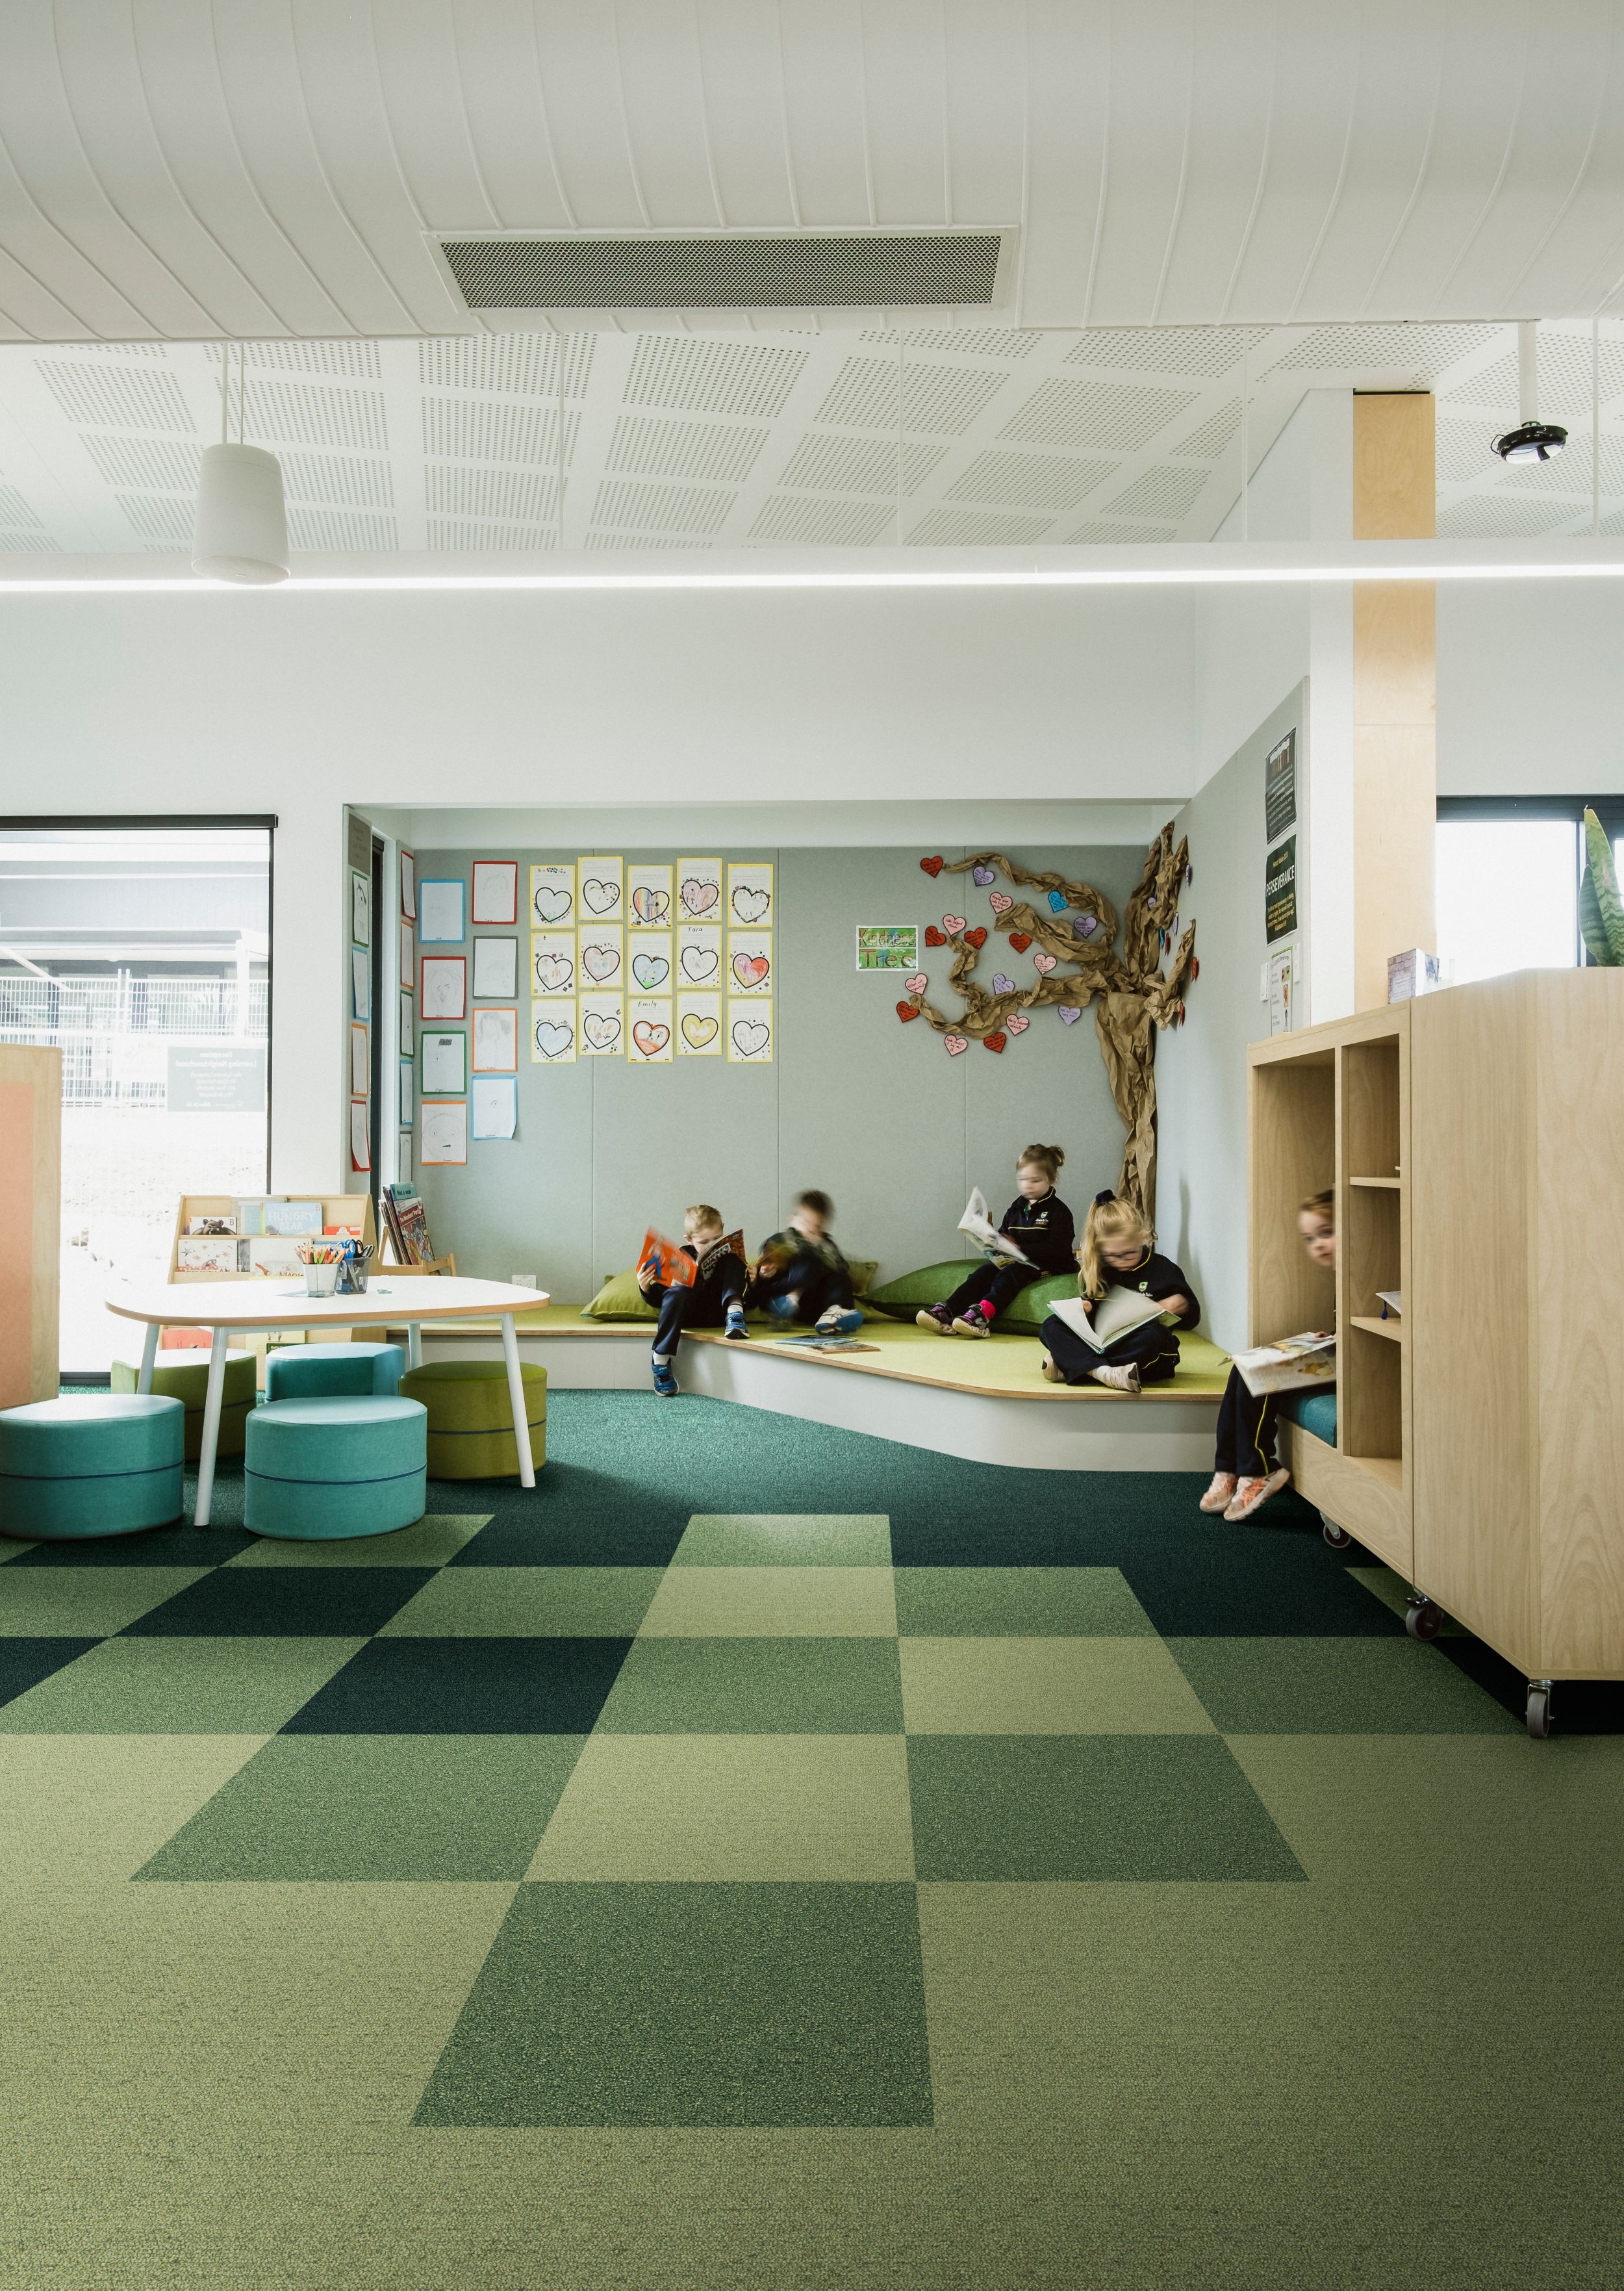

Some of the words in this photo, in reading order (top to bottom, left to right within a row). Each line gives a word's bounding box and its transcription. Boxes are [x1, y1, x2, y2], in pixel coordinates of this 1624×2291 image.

[1266, 865, 1295, 897] PERSEVERANCE
[858, 929, 915, 947] Kindness
[859, 949, 915, 967] Tree
[268, 1211, 315, 1222] HUNGRY
[280, 1222, 304, 1231] BEAR
